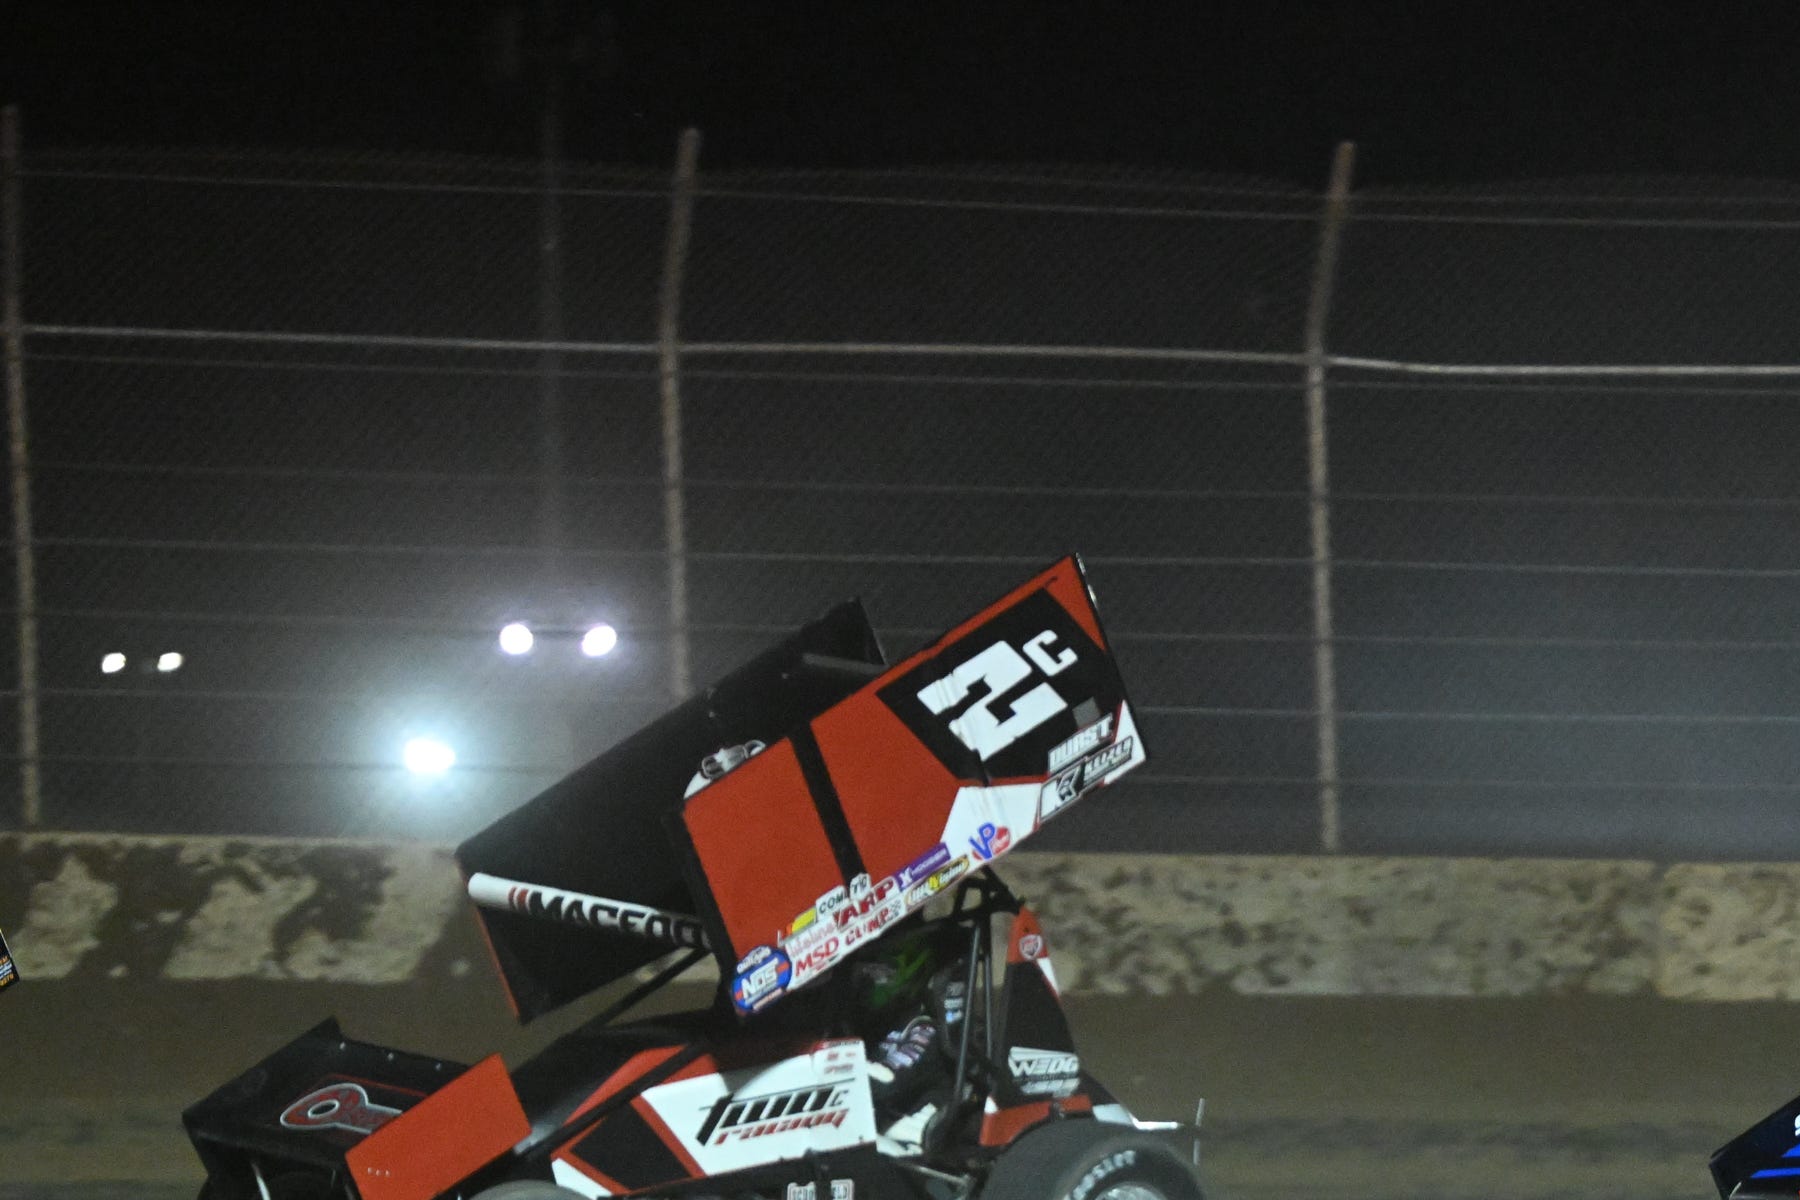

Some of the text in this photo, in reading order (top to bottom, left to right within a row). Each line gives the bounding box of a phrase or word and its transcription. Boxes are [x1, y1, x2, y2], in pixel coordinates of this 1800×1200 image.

[969, 823, 995, 860] VP
[794, 936, 840, 977] MSD
[742, 958, 779, 998] NOS
